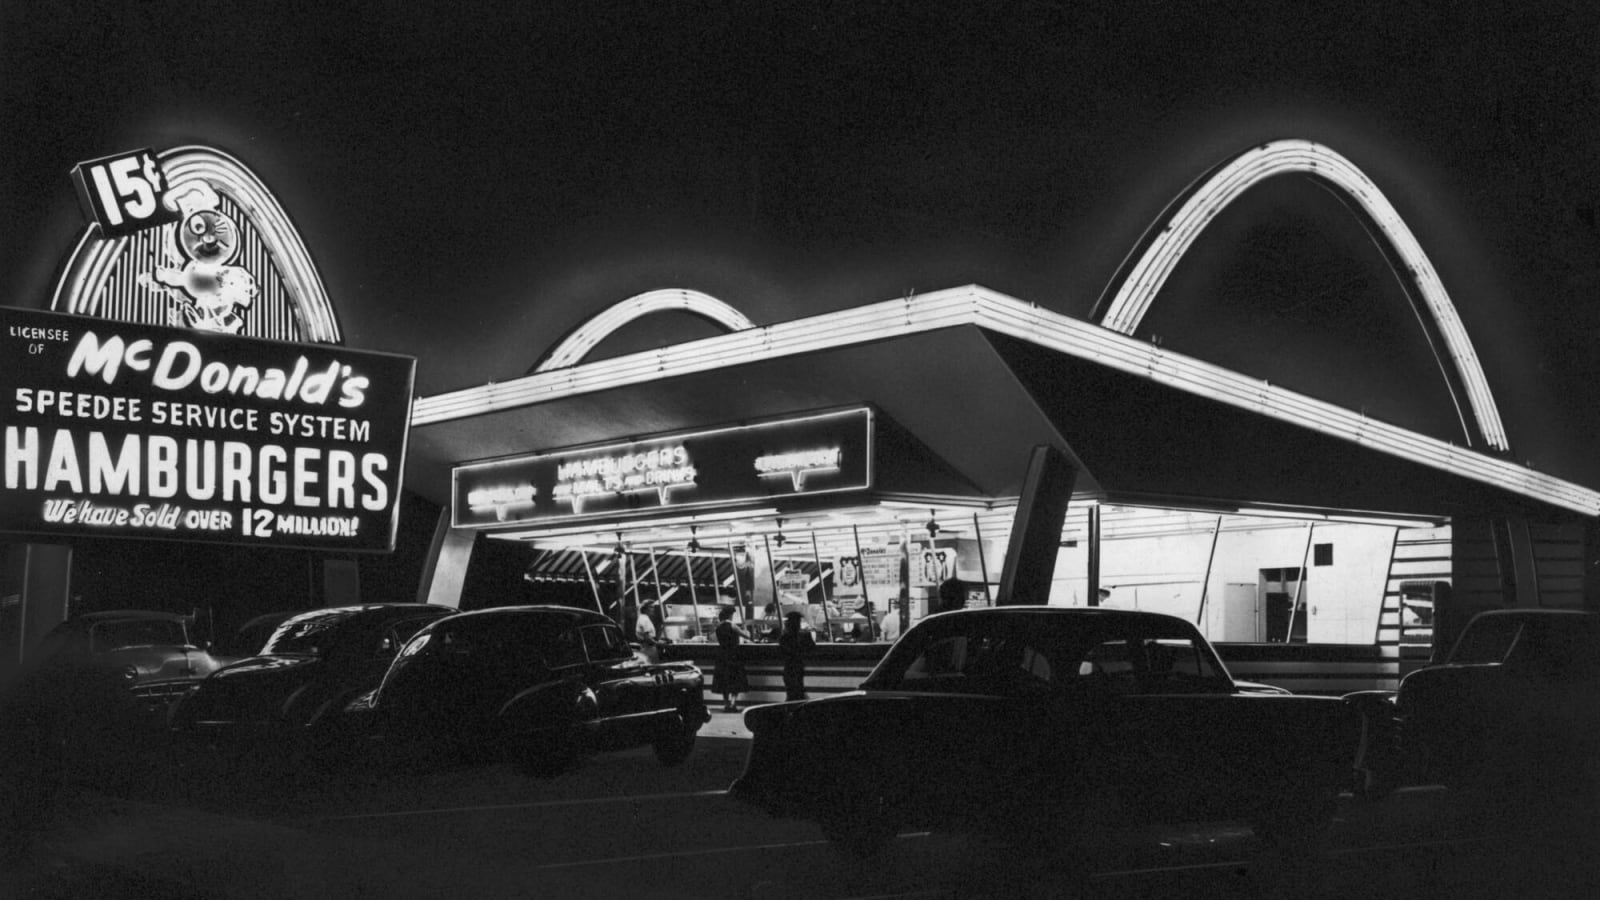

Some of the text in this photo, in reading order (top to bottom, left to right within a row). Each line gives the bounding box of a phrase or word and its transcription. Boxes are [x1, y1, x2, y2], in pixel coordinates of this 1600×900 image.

[91, 154, 162, 226] 15¢
[10, 326, 69, 342] LICENSEE
[28, 343, 45, 354] OF
[67, 330, 370, 408] McDonald's
[16, 388, 370, 442] SPEEDEE SERVICE SYSTEM
[4, 426, 389, 511] HAMBURGERS
[77, 501, 128, 526] have
[130, 503, 180, 529] Sold
[185, 508, 232, 531] OVER
[243, 508, 274, 537] 12
